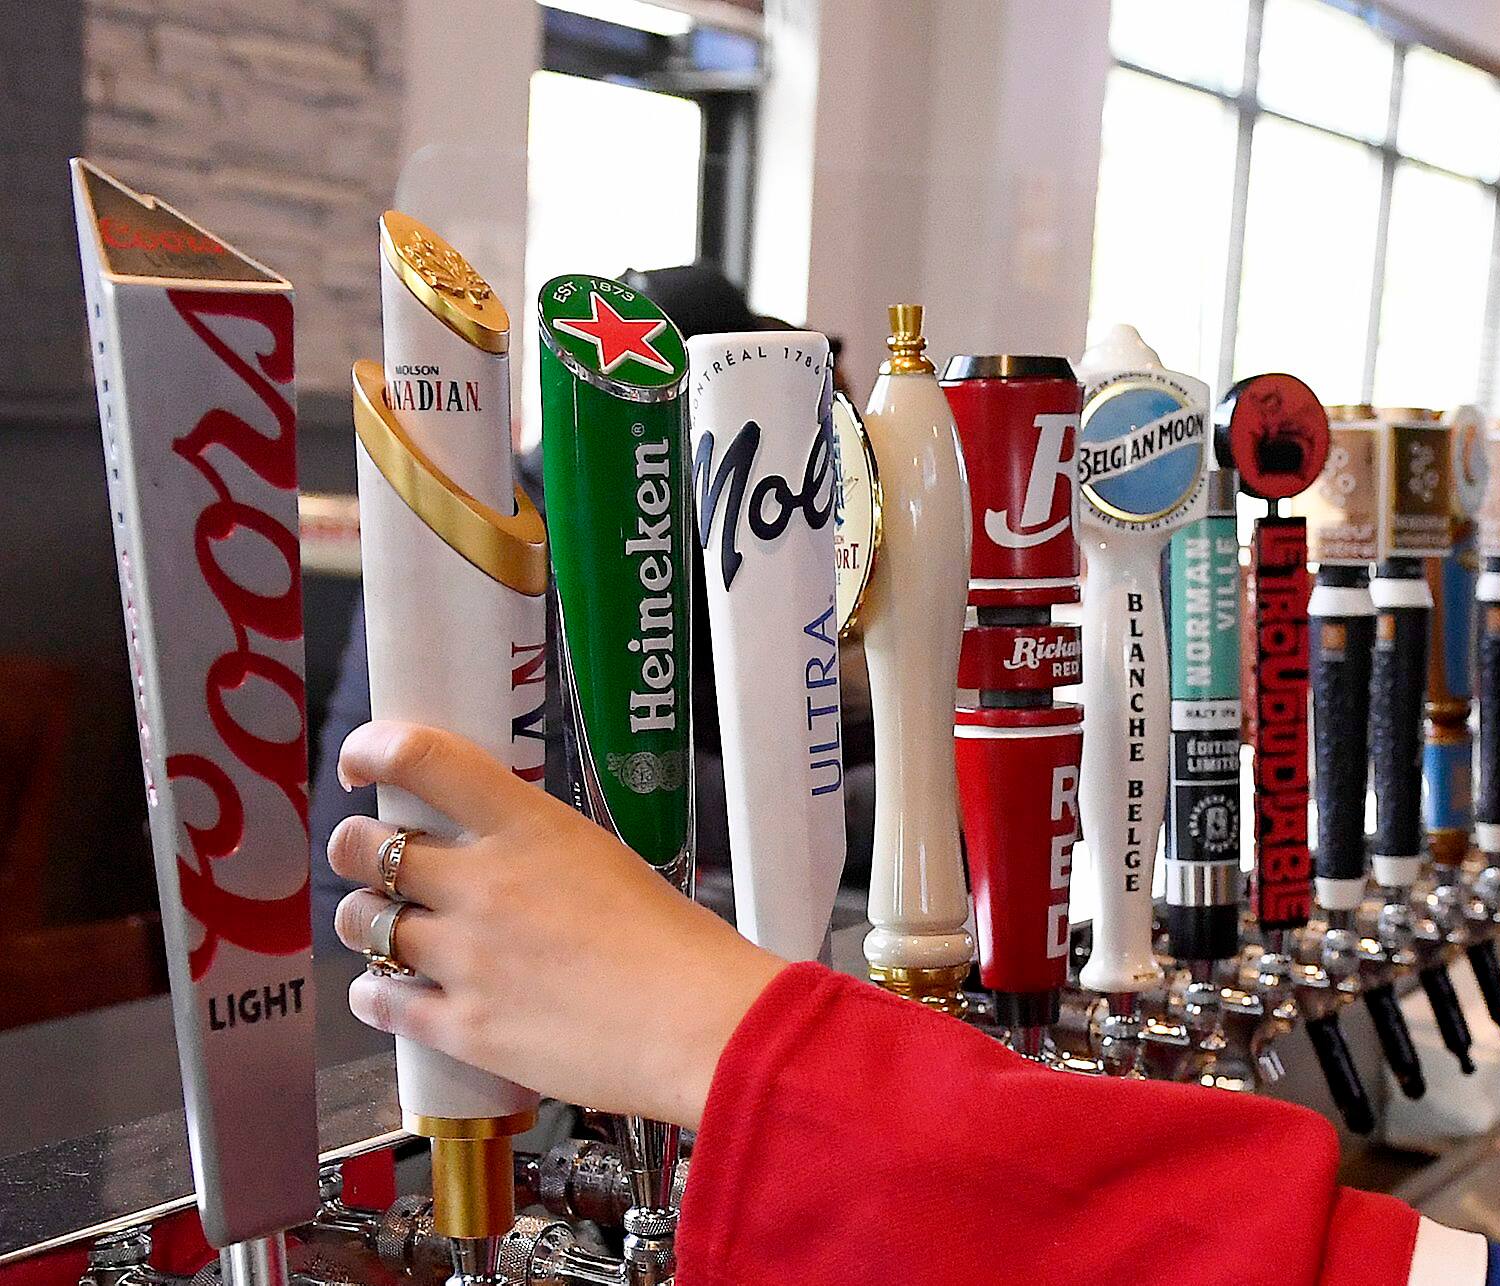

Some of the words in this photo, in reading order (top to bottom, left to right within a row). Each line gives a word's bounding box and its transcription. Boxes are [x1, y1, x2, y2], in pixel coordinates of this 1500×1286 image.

[590, 279, 635, 302] 1873
[692, 346, 767, 428] ONTRÉAL
[784, 347, 820, 375] 1786
[1079, 430, 1155, 485] BELGIAN
[1158, 413, 1205, 450] MOON
[625, 437, 676, 734] Heineken
[1185, 537, 1211, 687] NORMAN
[1215, 537, 1236, 631] VILLE
[804, 605, 843, 796] ULTRA
[1128, 593, 1146, 763] BLANCHE
[1047, 765, 1079, 960] RED
[1125, 780, 1144, 893] BELGE
[208, 978, 305, 1032] LIGHT
